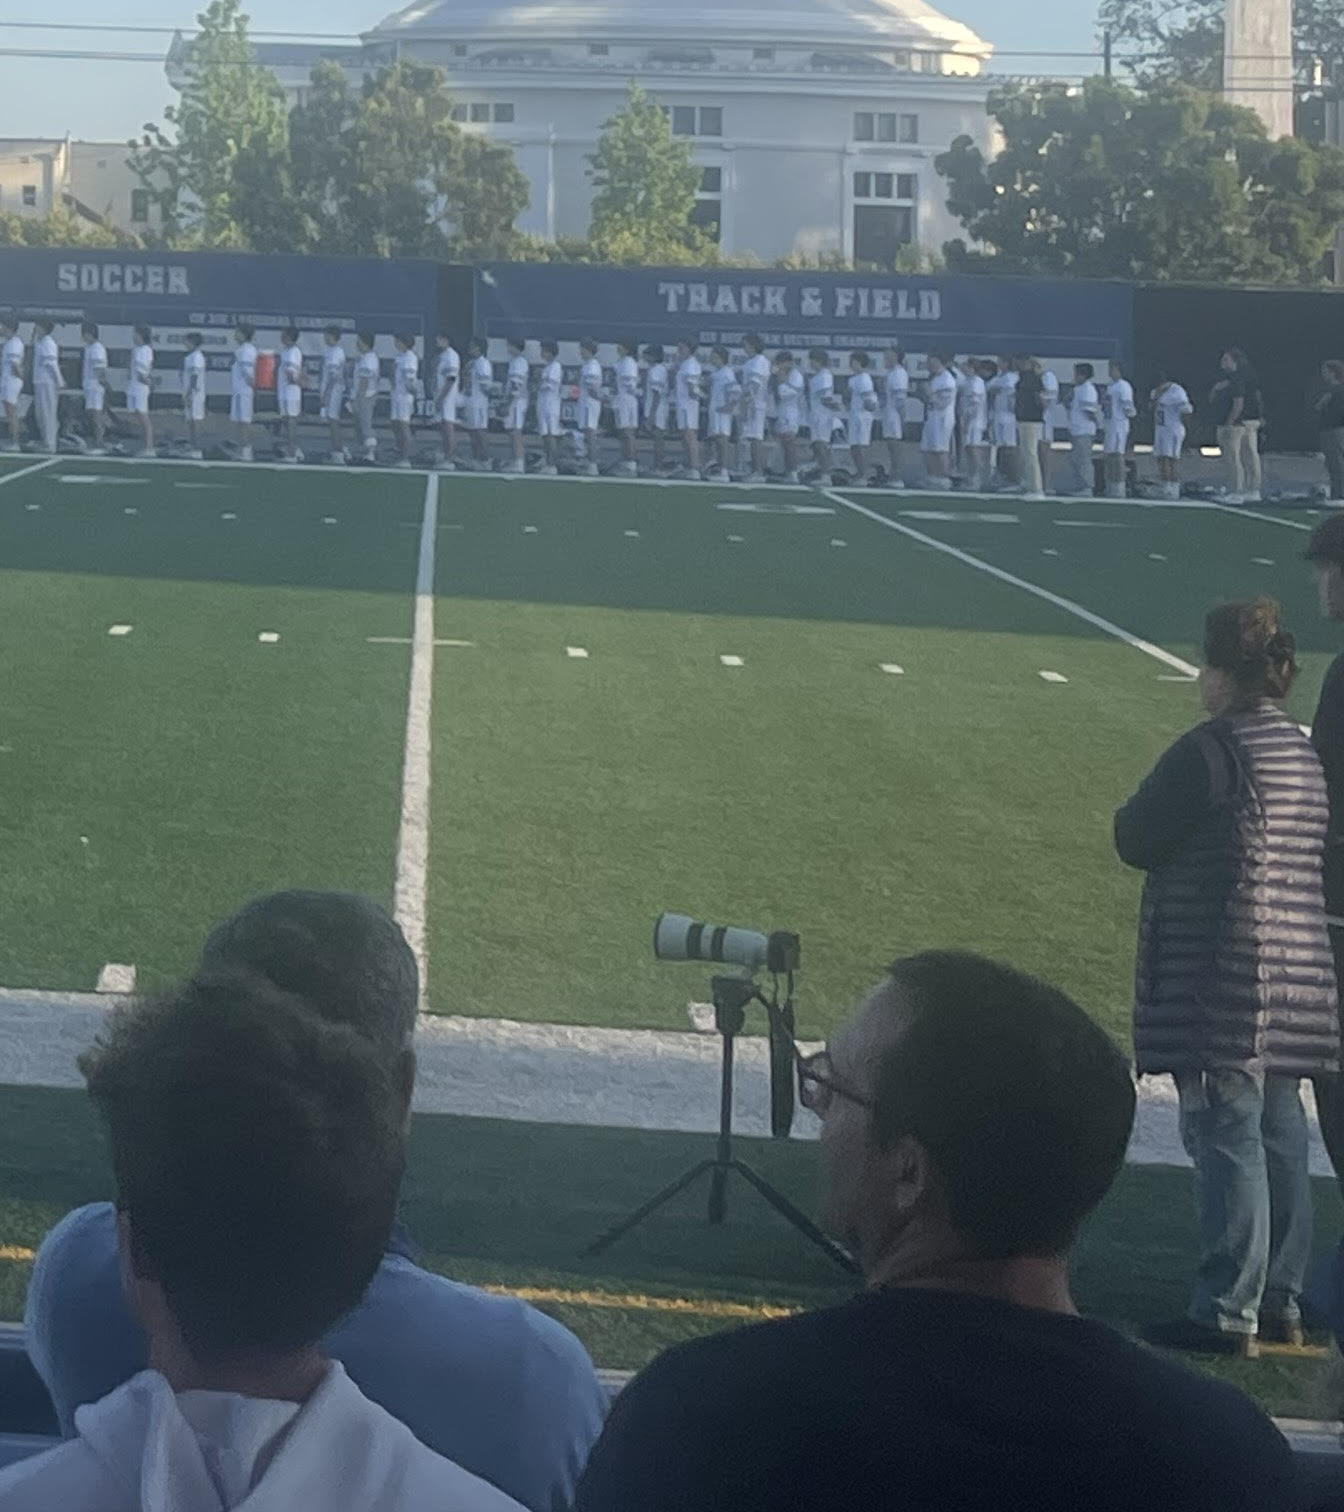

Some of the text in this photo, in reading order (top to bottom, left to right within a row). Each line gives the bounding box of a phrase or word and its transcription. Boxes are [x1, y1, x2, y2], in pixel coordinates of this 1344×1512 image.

[58, 263, 191, 295] SOCCER
[658, 281, 941, 321] TRACK & FIELD
